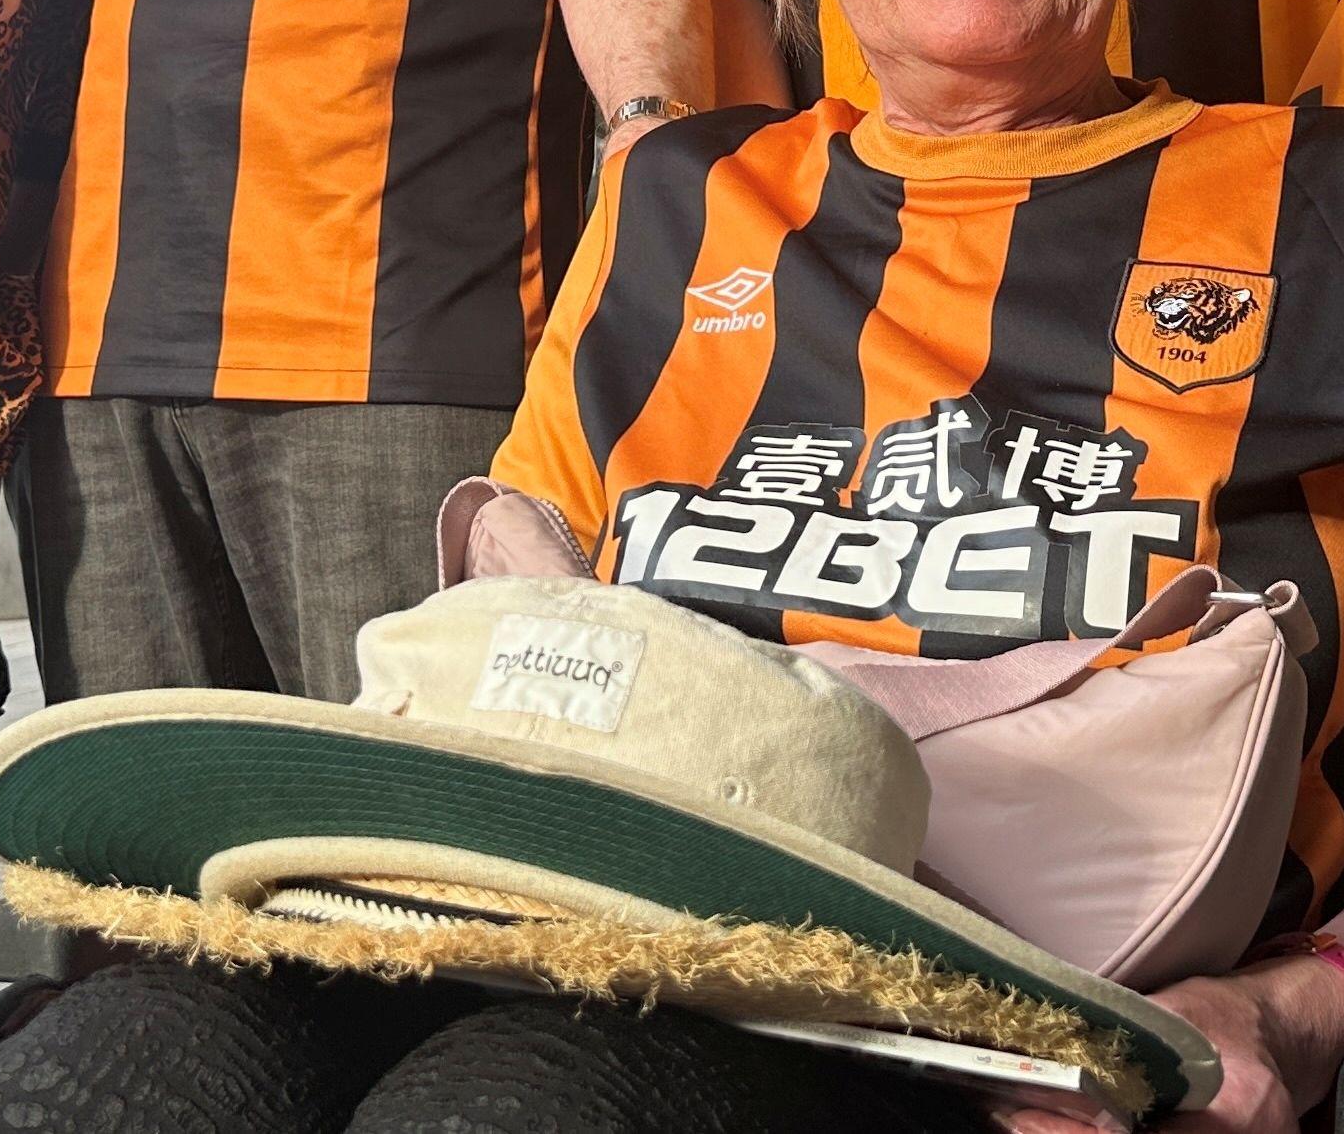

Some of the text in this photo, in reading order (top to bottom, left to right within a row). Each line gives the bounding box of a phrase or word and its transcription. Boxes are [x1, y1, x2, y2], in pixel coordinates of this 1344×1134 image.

[692, 311, 767, 333] umbro
[1157, 346, 1207, 364] 1904
[618, 488, 1181, 631] 12BET
